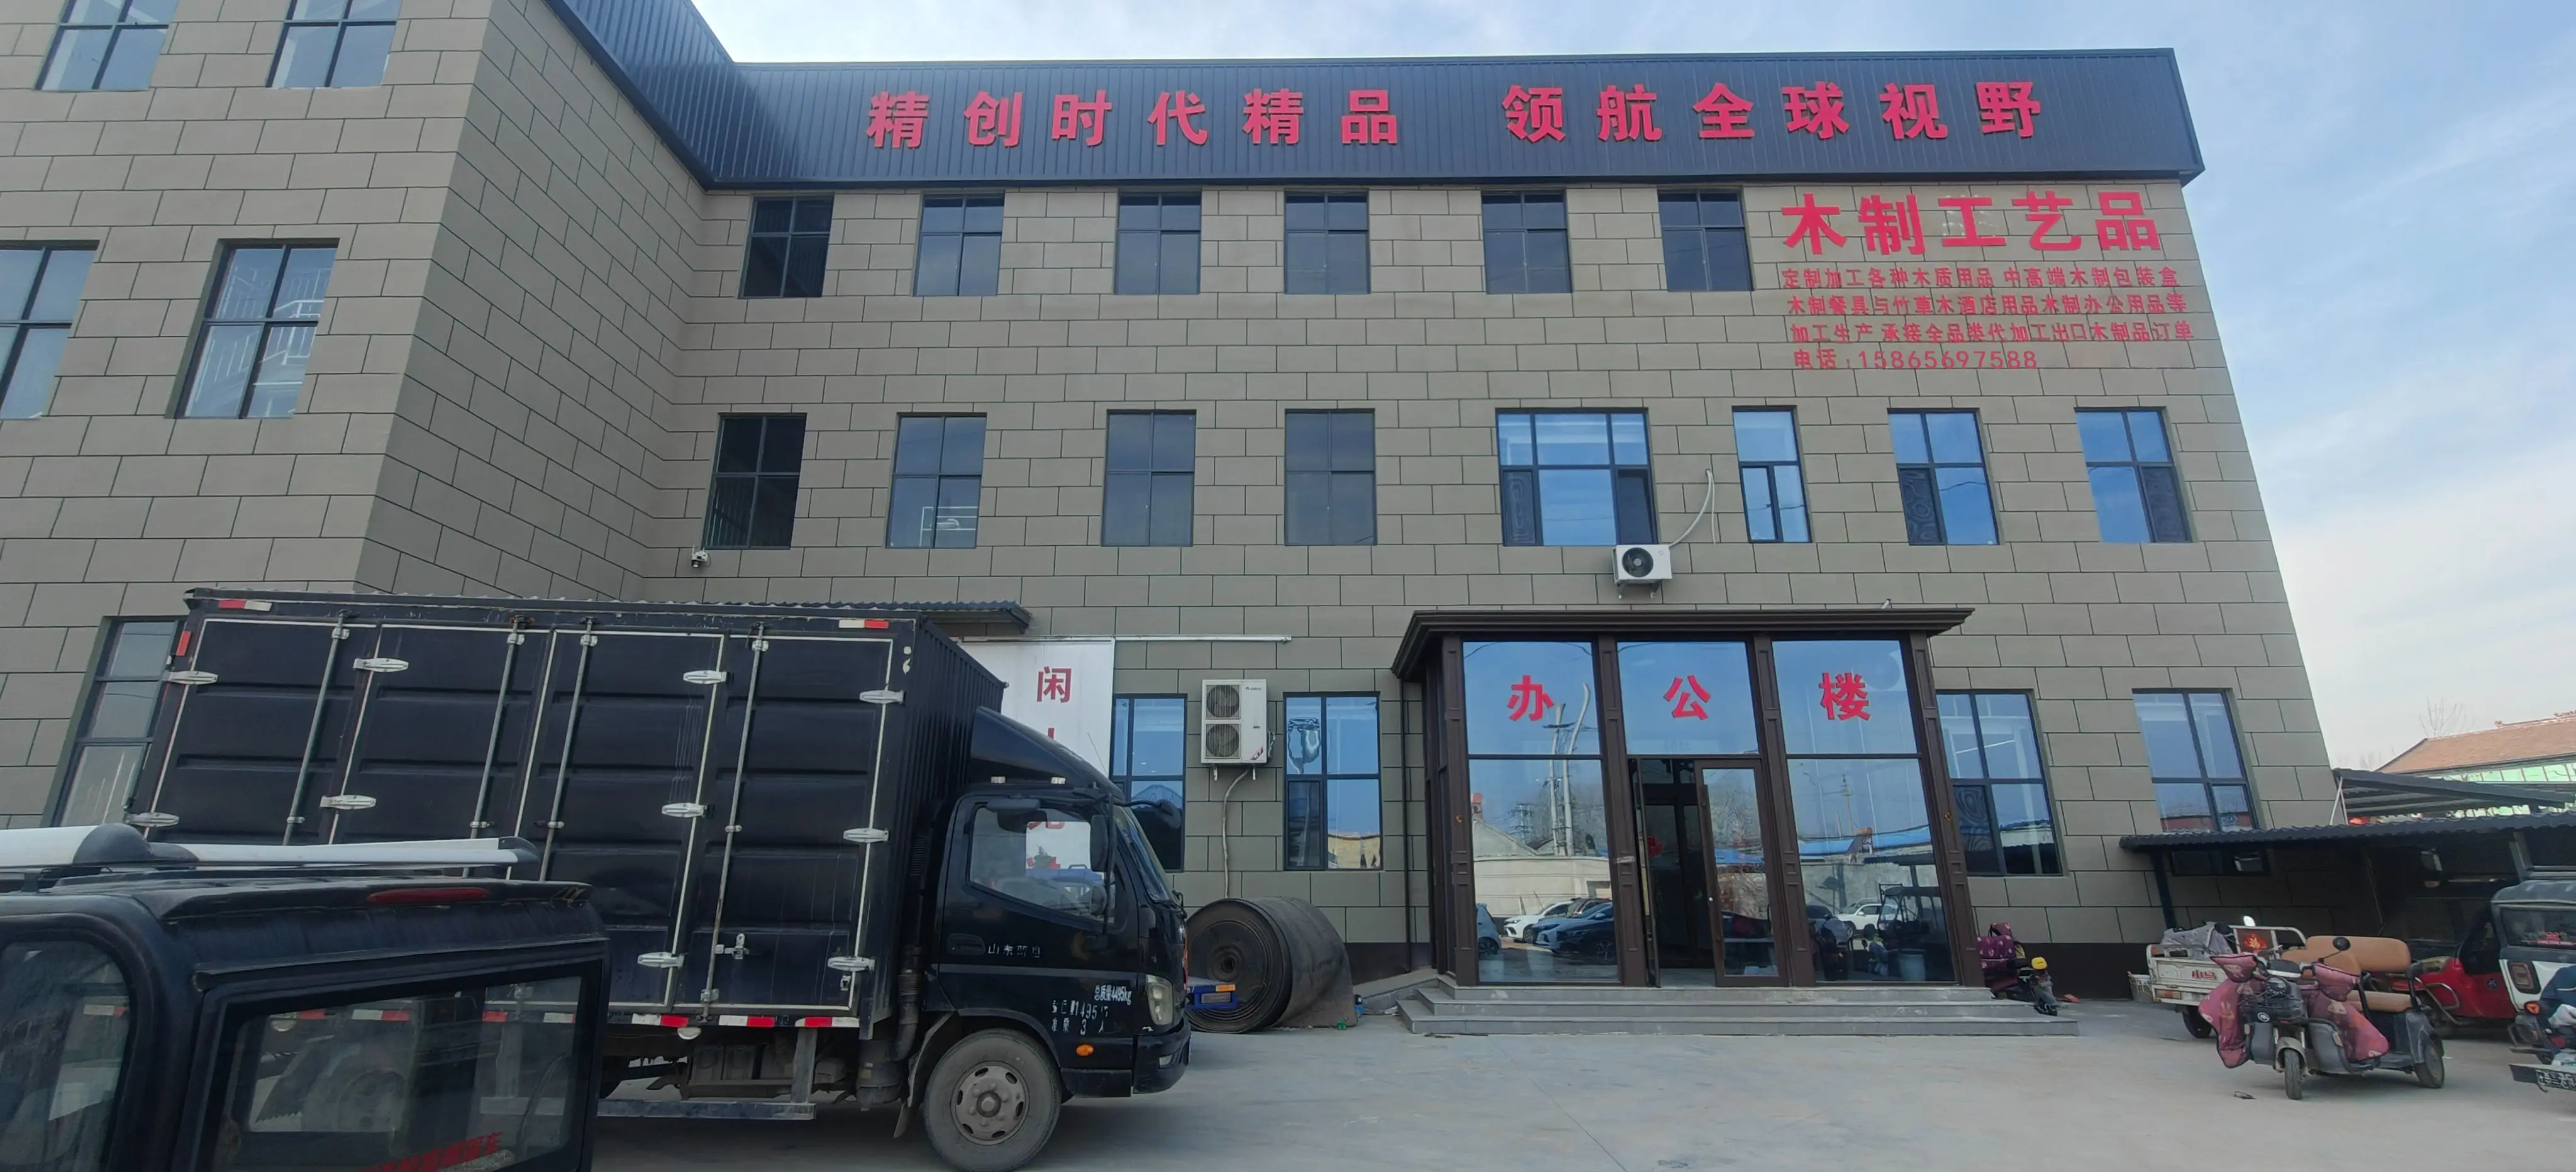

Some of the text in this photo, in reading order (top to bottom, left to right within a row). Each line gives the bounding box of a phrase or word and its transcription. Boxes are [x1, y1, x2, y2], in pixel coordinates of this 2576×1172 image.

[866, 80, 2042, 148] 精创时代精品 领航全球视野
[1781, 191, 2162, 255] 木制工艺品
[1782, 266, 2181, 289] 定制加工各种木质用品 中高端木制包装盒
[1790, 323, 1873, 343] 加工生产
[1507, 673, 1872, 722] 办公楼
